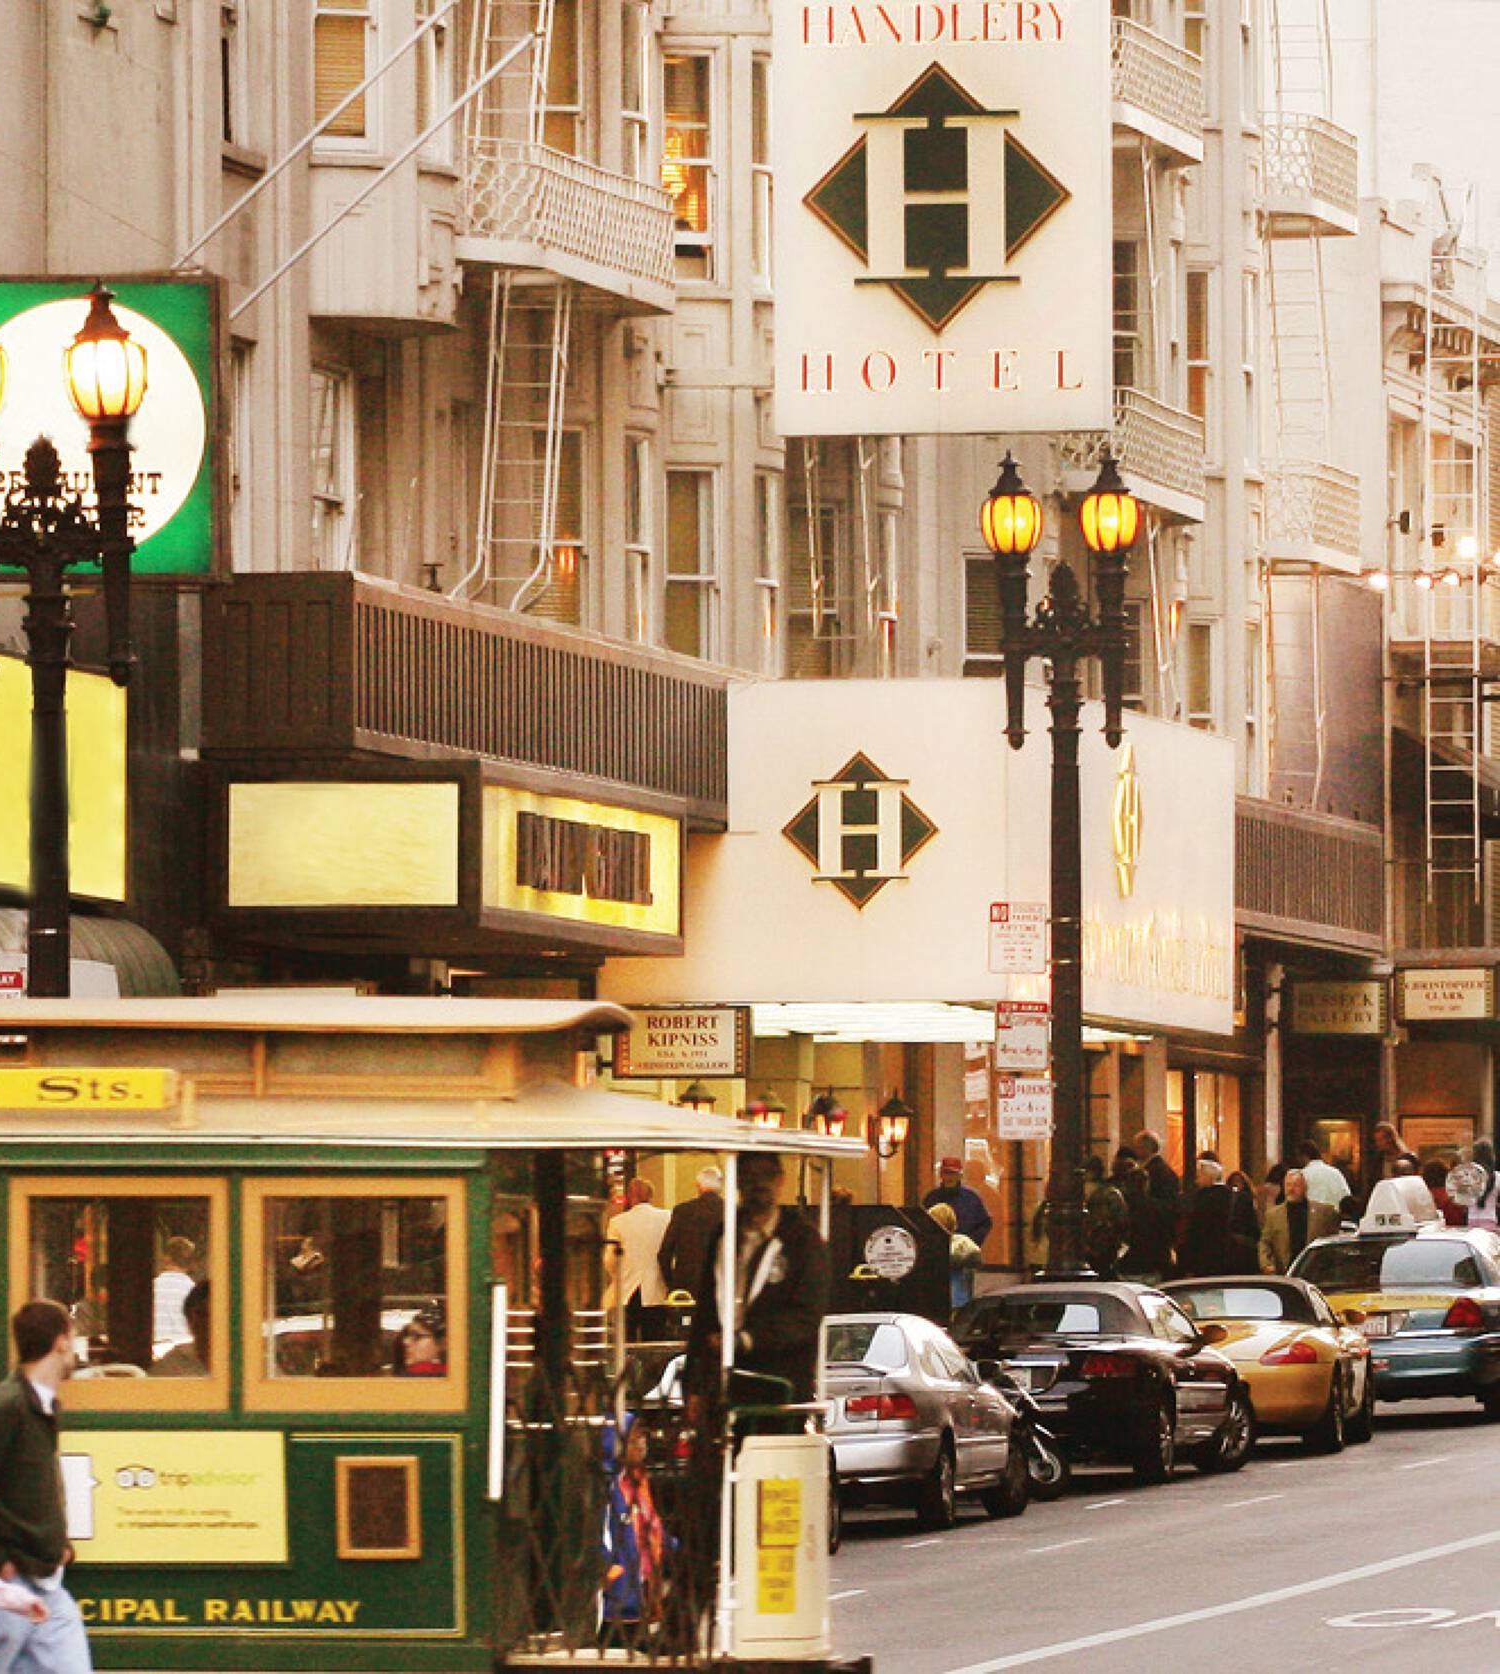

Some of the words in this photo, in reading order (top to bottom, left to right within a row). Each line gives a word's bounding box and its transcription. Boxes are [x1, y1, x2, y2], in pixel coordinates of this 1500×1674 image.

[802, 1, 1067, 45] HANDLERY
[801, 350, 1084, 392] HOTEL
[647, 1015, 719, 1029] ROBERT
[647, 1032, 719, 1047] KIPNISS
[37, 1075, 144, 1102] Sts.
[77, 1598, 189, 1622] CIPAL
[203, 1598, 361, 1623] RAILWAY
